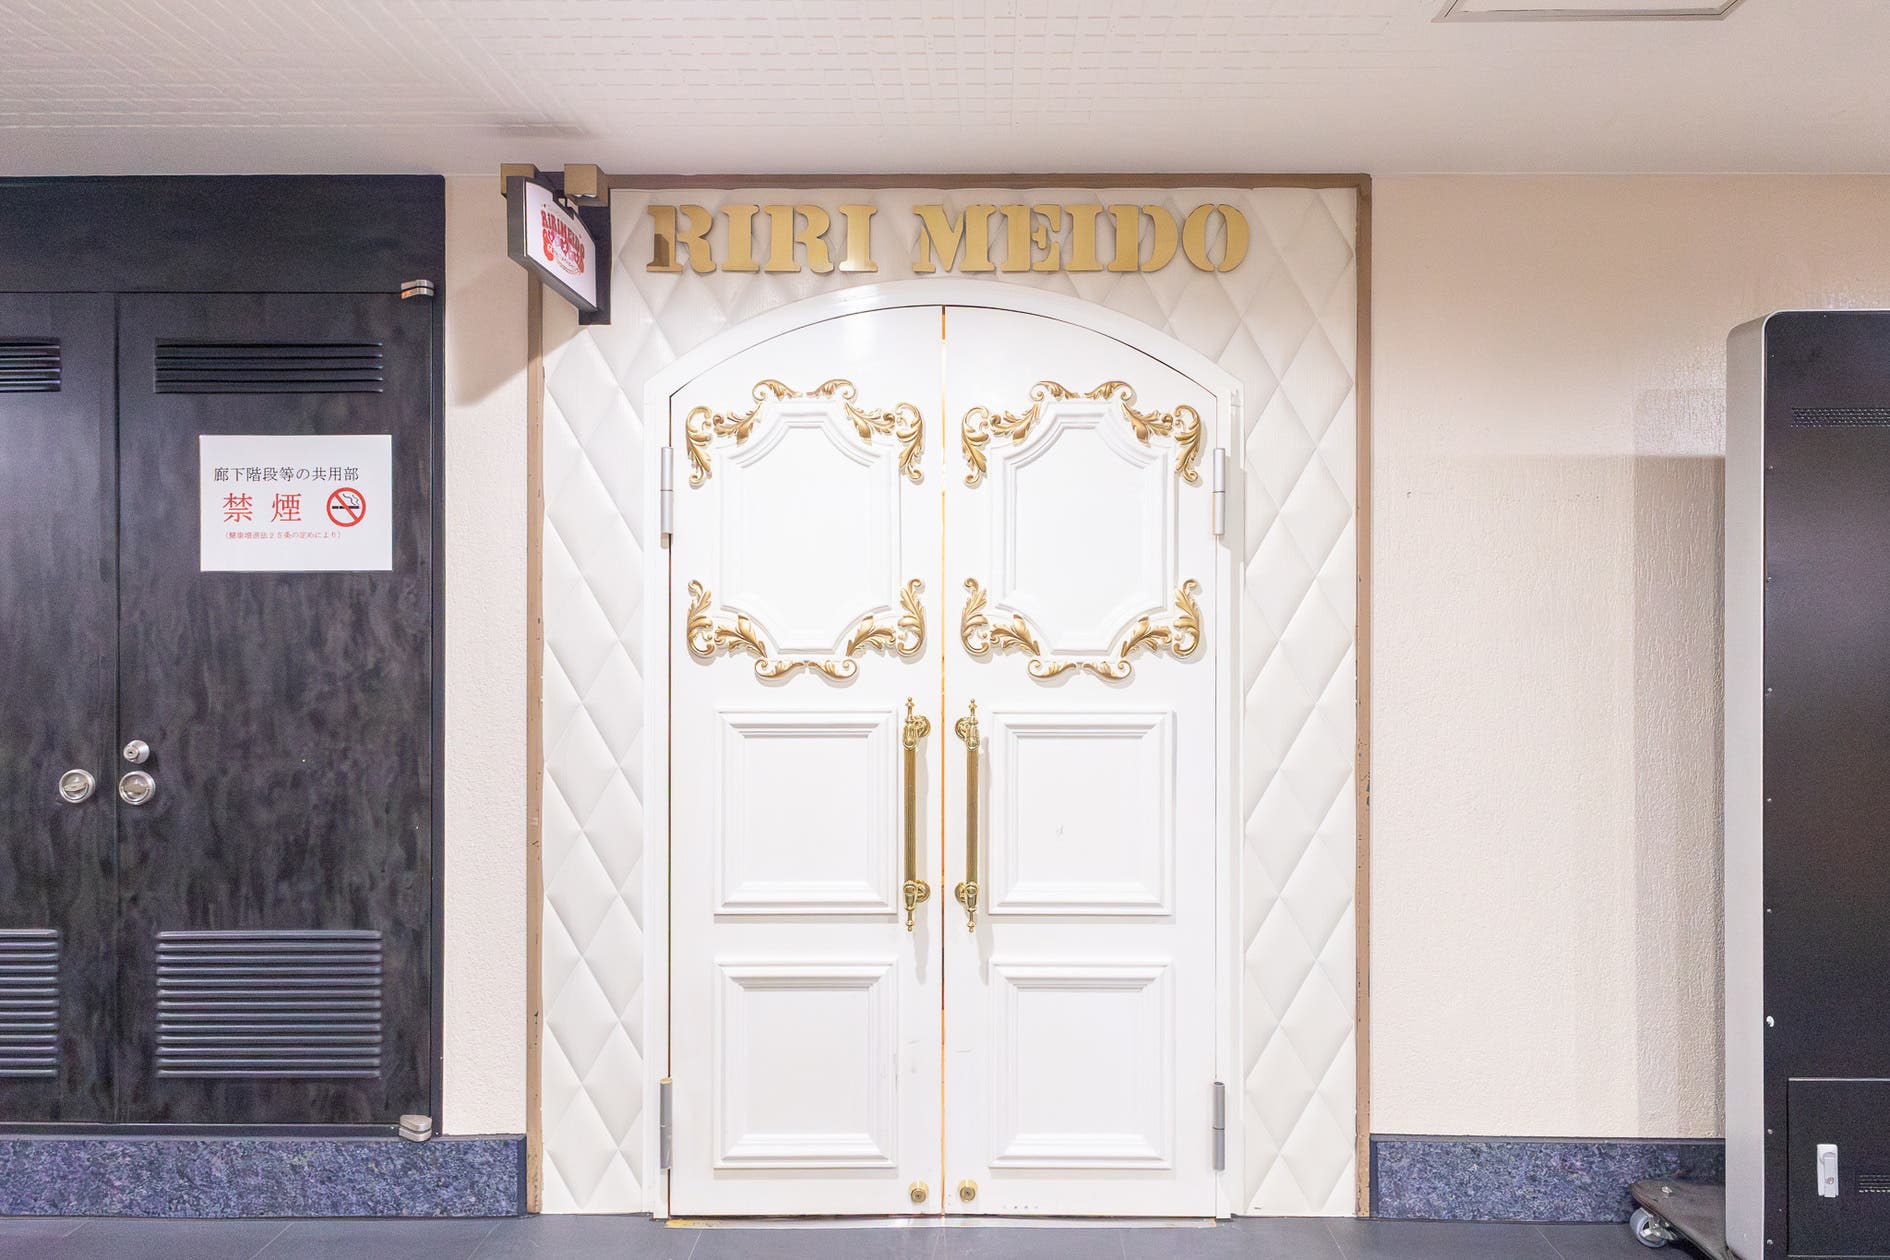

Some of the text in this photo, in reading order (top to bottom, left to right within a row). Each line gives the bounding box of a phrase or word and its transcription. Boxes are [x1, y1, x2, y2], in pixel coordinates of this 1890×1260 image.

[646, 203, 1250, 273] RIRI MEIDO
[213, 466, 359, 482] 廊下階段等の共用部
[223, 492, 302, 523] 禁煙
